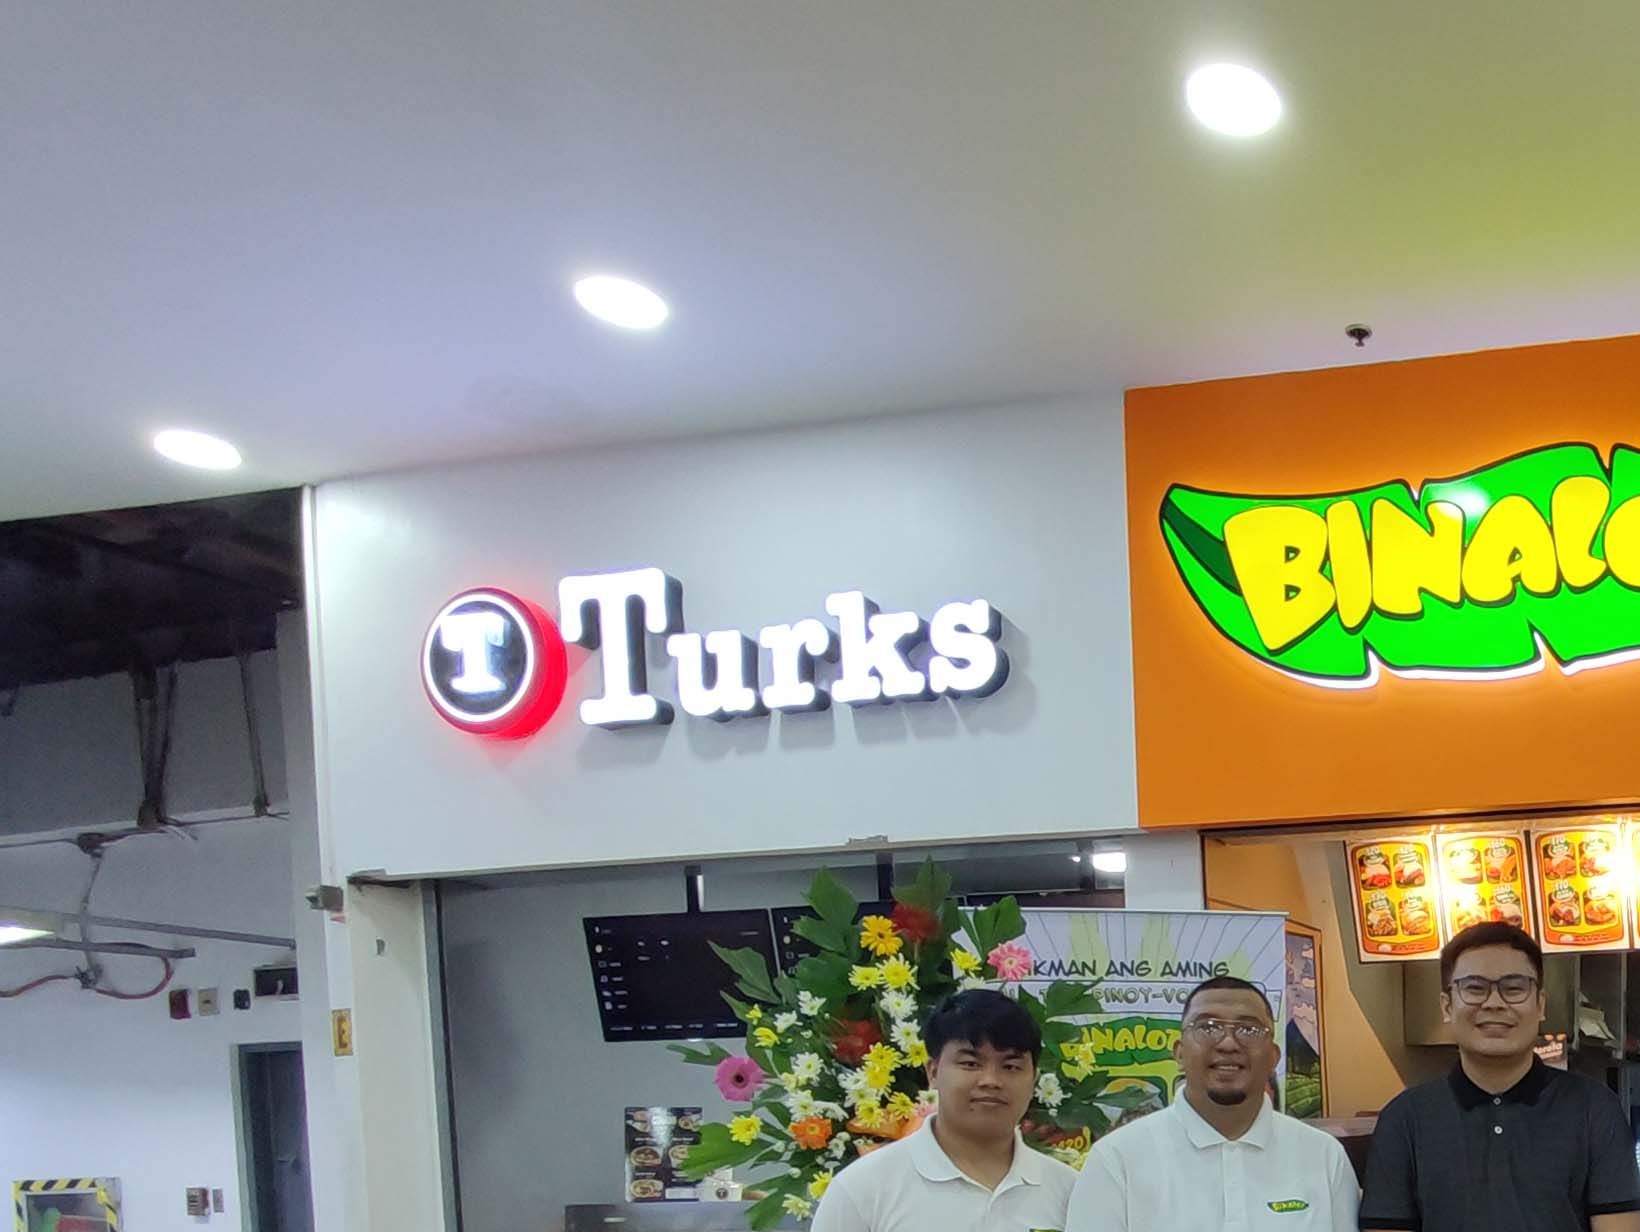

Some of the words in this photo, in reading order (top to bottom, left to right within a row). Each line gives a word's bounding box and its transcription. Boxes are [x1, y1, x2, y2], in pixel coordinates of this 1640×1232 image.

[558, 567, 1001, 725] Turks
[1027, 960, 1096, 977] IKMAN
[1105, 961, 1152, 977] ANG
[1160, 962, 1229, 978] AMING
